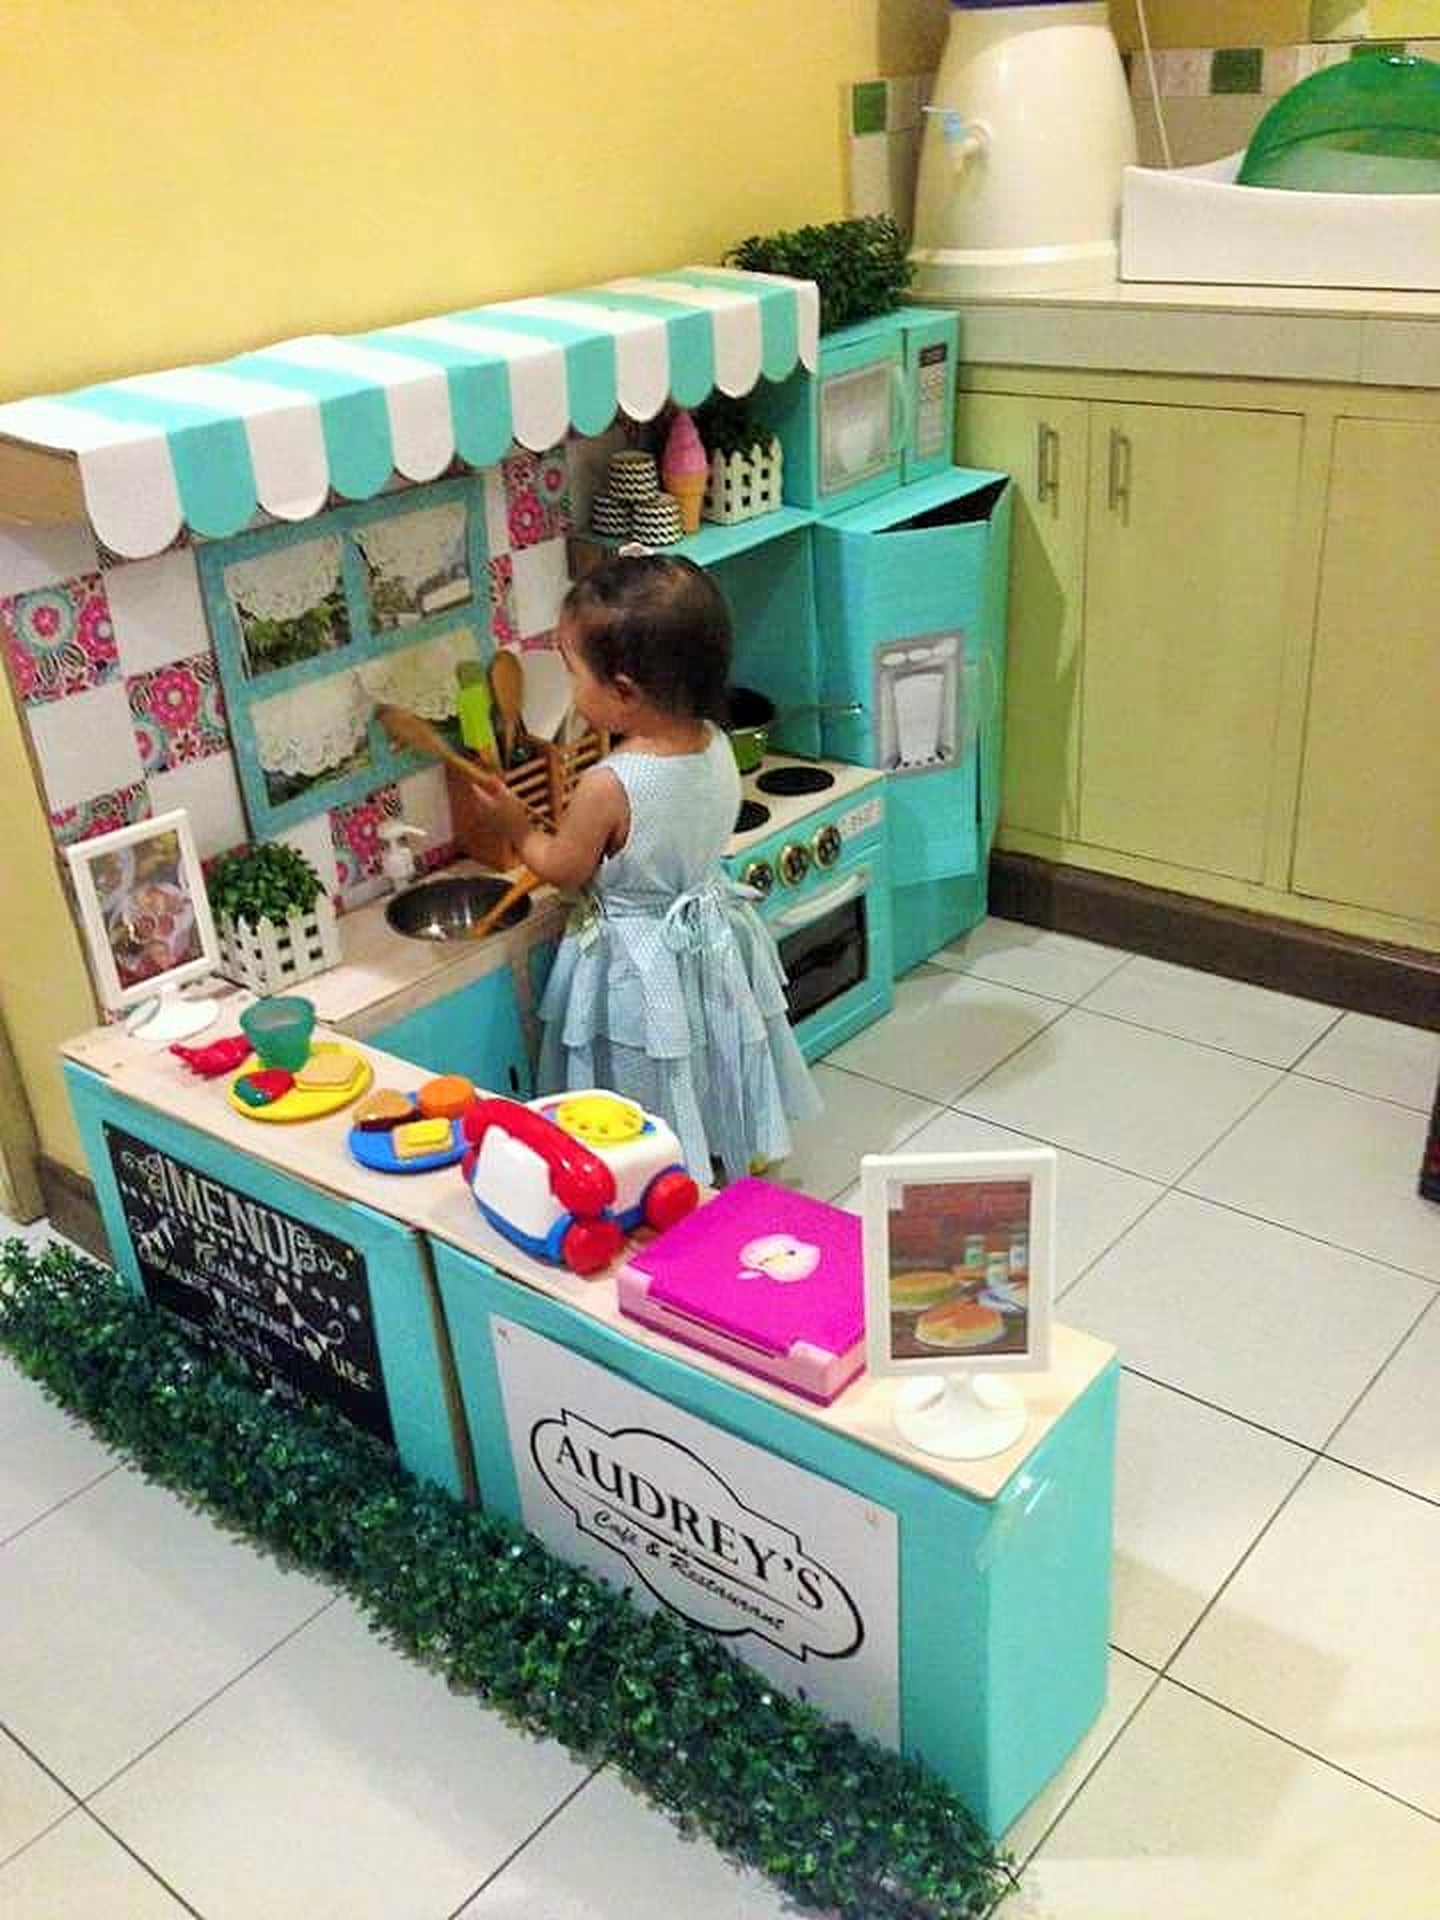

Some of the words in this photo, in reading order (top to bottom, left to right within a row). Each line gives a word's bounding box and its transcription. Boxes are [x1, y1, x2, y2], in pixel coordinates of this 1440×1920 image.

[163, 1157, 290, 1267] MENU
[556, 1435, 825, 1611] AUDREY'S
[646, 1542, 662, 1559] &
[669, 1552, 786, 1631] Restaurant
